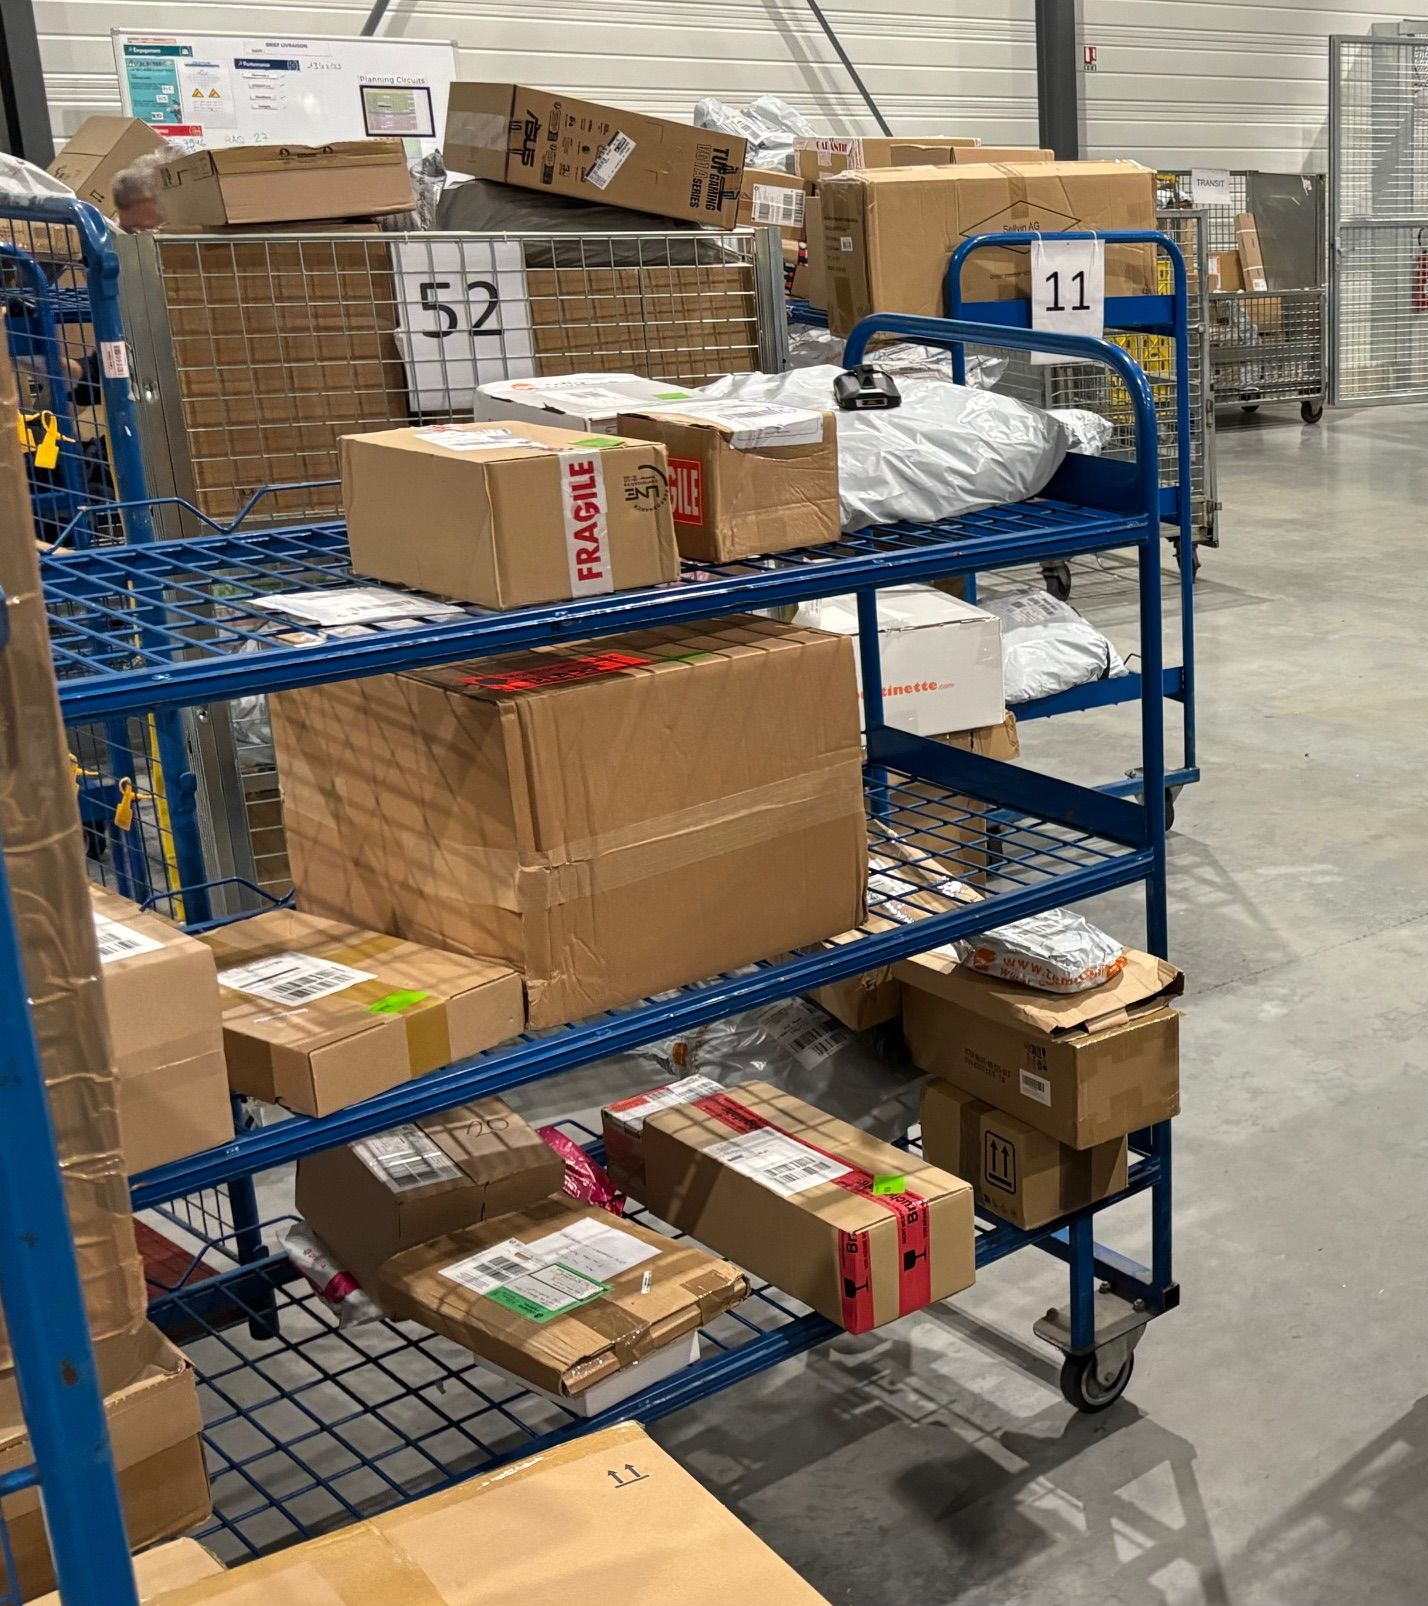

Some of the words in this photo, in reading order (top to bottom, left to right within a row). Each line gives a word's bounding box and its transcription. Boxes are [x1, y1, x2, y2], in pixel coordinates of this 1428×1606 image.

[359, 76, 395, 84] Planning
[396, 76, 426, 84] Circuits
[689, 177, 702, 209] SERIES
[705, 171, 721, 212] GAMING
[1197, 178, 1225, 188] TRANSIT
[1028, 220, 1040, 232] AG
[419, 280, 504, 340] 52
[1045, 270, 1090, 314] 11
[668, 464, 700, 517] GILE
[568, 460, 603, 582] FRAGILE
